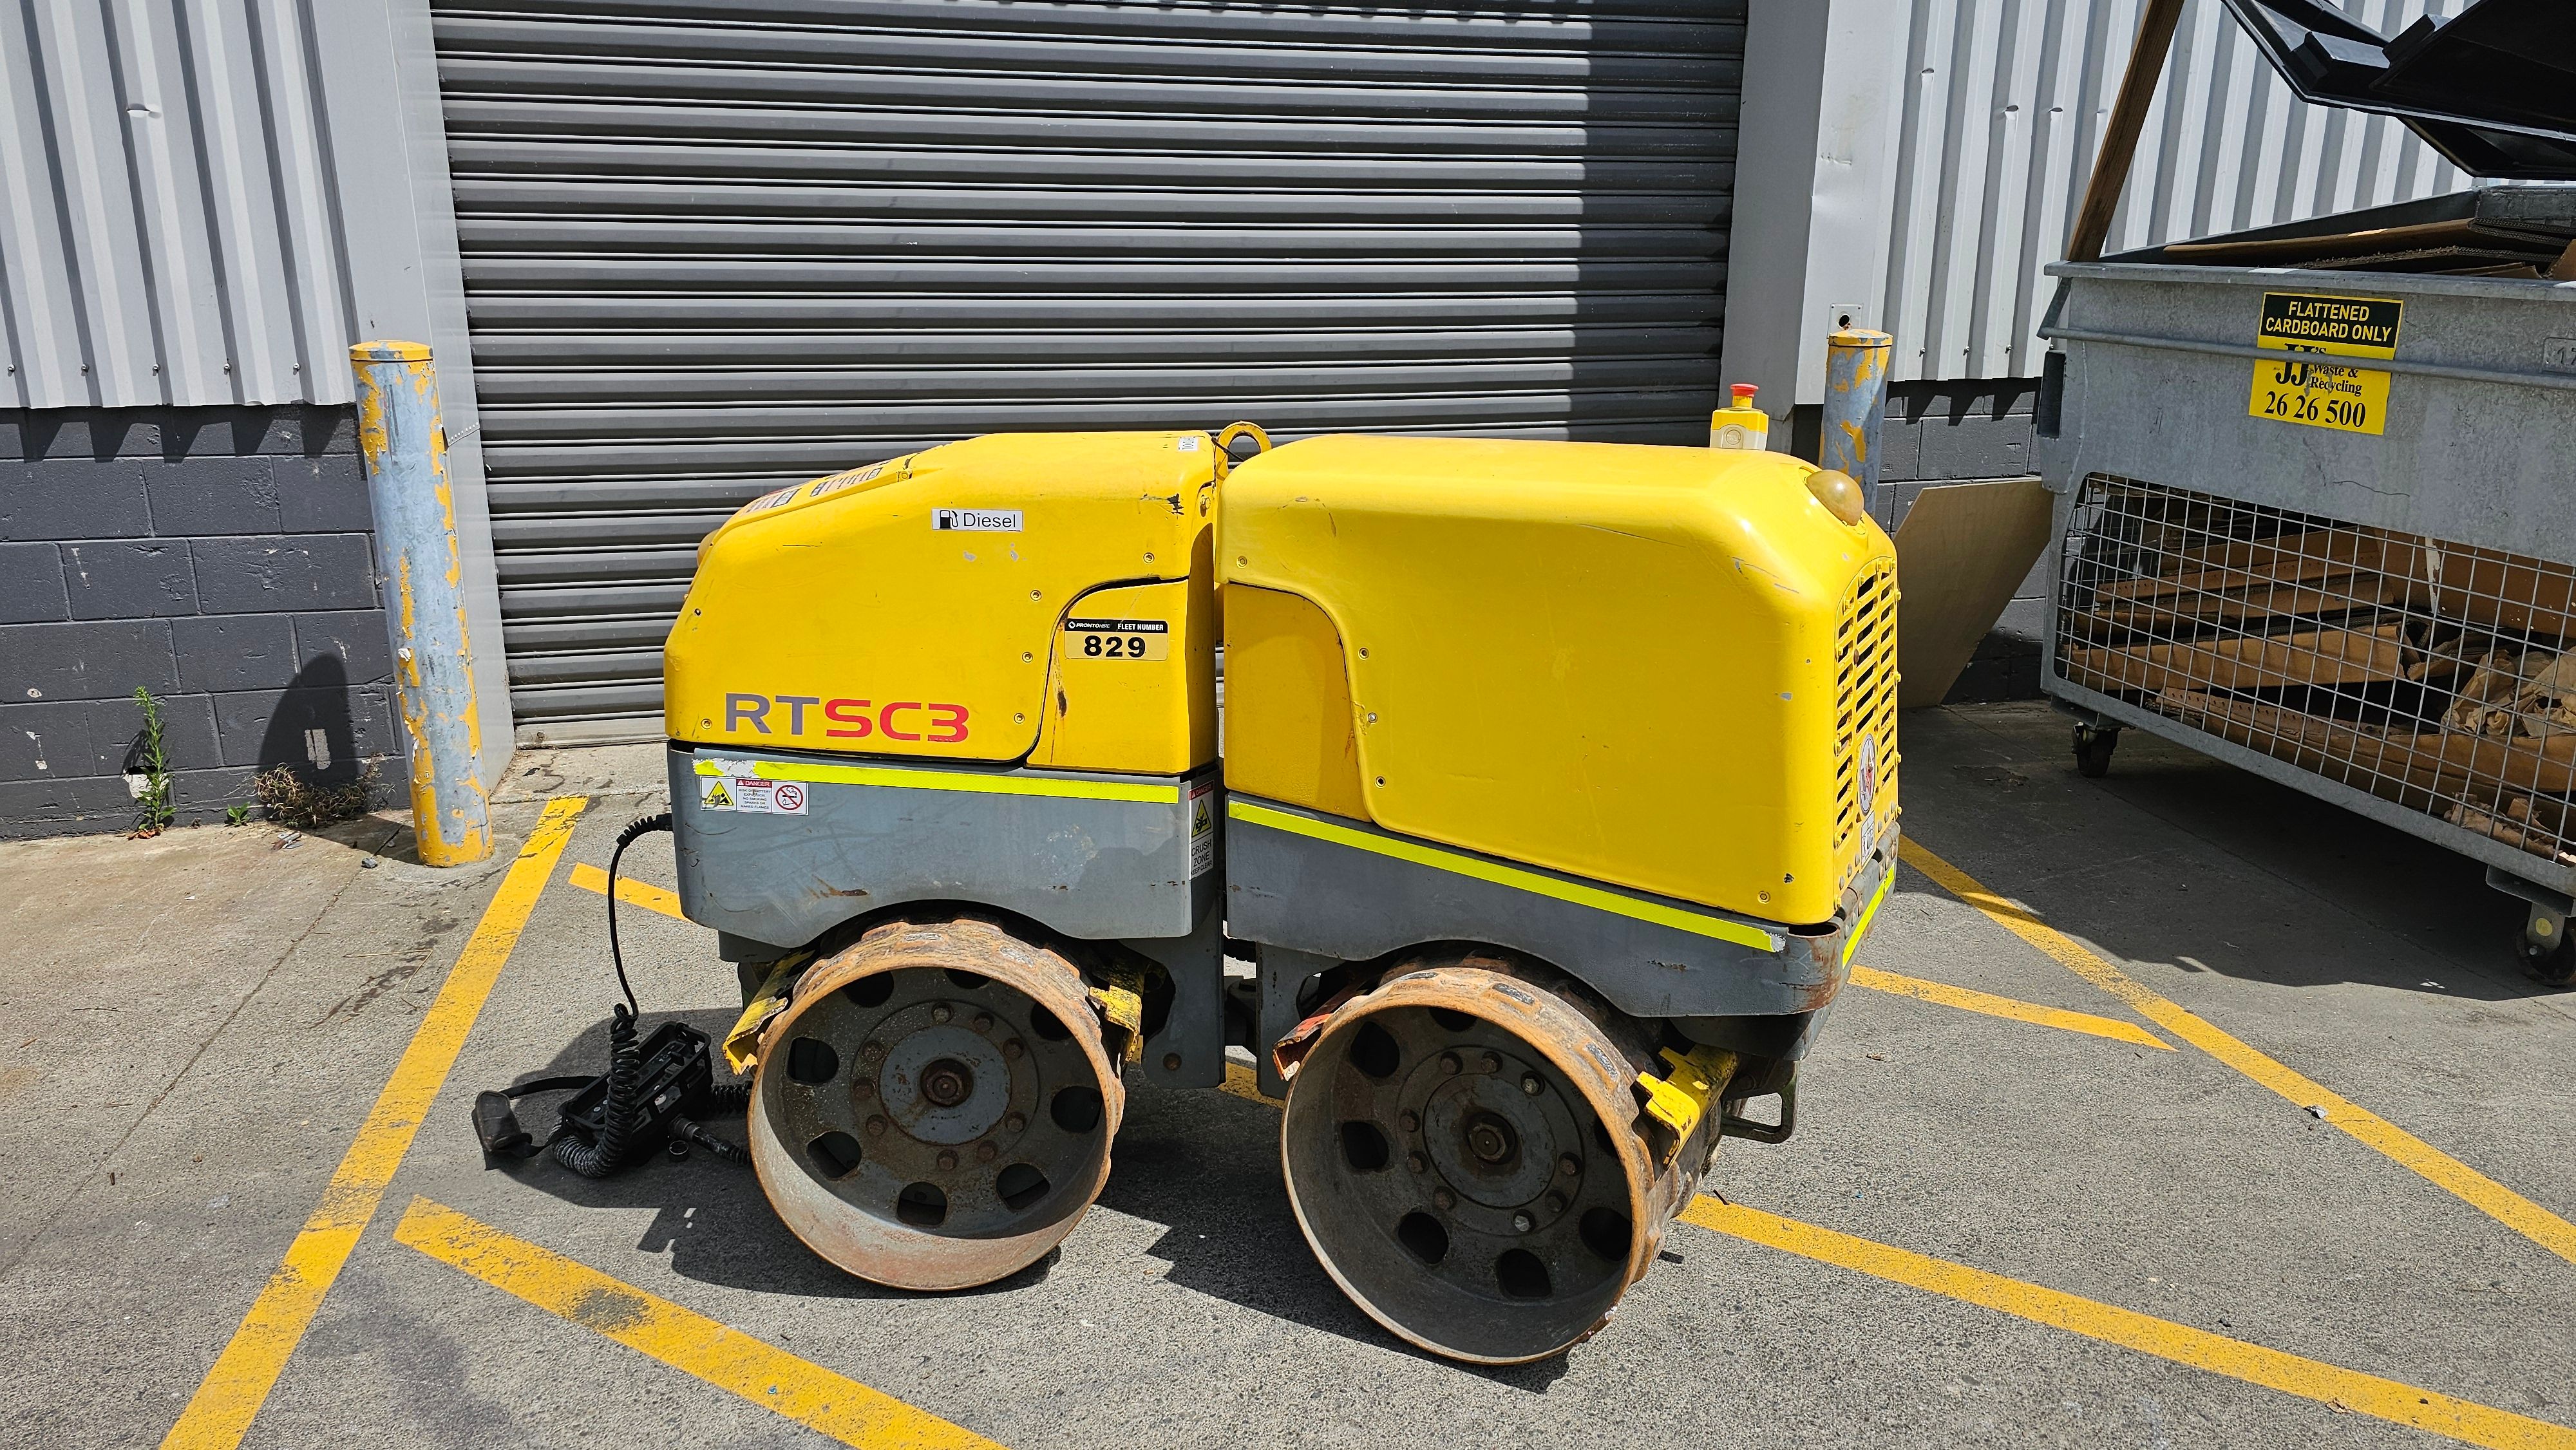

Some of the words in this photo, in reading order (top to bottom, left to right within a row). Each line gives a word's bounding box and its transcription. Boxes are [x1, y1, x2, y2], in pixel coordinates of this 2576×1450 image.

[2288, 301, 2369, 321] FLATTENED
[2266, 317, 2349, 338] CARDBOARD
[2352, 325, 2392, 342] ONLY
[2313, 364, 2345, 377] Waste
[2347, 367, 2359, 379] &
[2309, 377, 2363, 397] Recycling
[2264, 390, 2289, 417] 26
[2293, 395, 2320, 421] 26
[2325, 399, 2366, 428] 500
[963, 513, 1016, 528] Diesel
[1084, 635, 1146, 658] 829
[725, 692, 969, 742] RTSC3
[1195, 784, 1211, 796] DANGER
[1191, 838, 1212, 857] CRUSH
[1190, 866, 1200, 876] KEEP
[1200, 860, 1213, 871] CLEAR
[1193, 851, 1210, 867] ZONE
